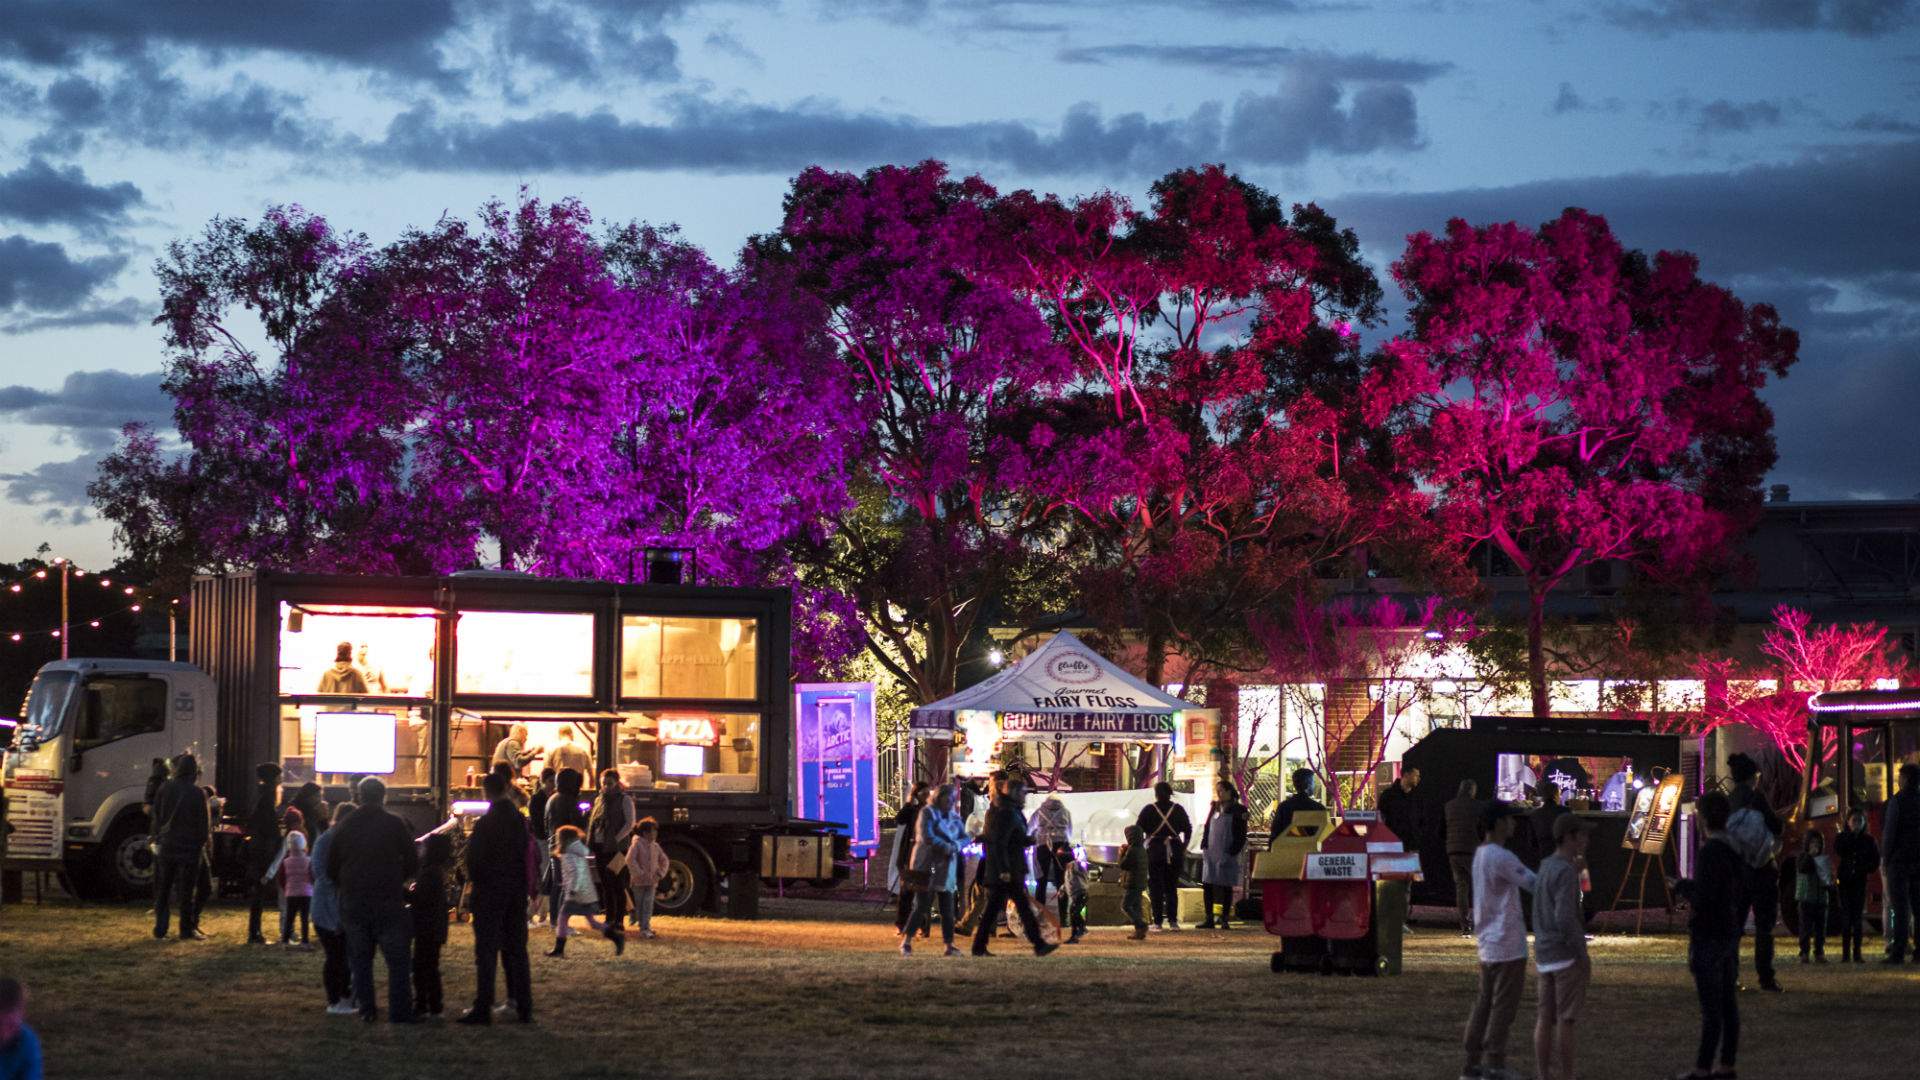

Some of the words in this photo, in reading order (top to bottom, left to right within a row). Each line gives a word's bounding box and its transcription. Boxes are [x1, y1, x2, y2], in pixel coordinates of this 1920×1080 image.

[1055, 687, 1107, 697] Gourmet
[1033, 695, 1081, 708] FAIRY
[1086, 695, 1138, 708] FLOSS
[1003, 712, 1077, 730] GOURMET
[1084, 713, 1125, 730] FAIRY
[659, 719, 715, 740] PIZZA
[1318, 856, 1356, 866] GENERAL
[1323, 866, 1352, 876] WASTE
